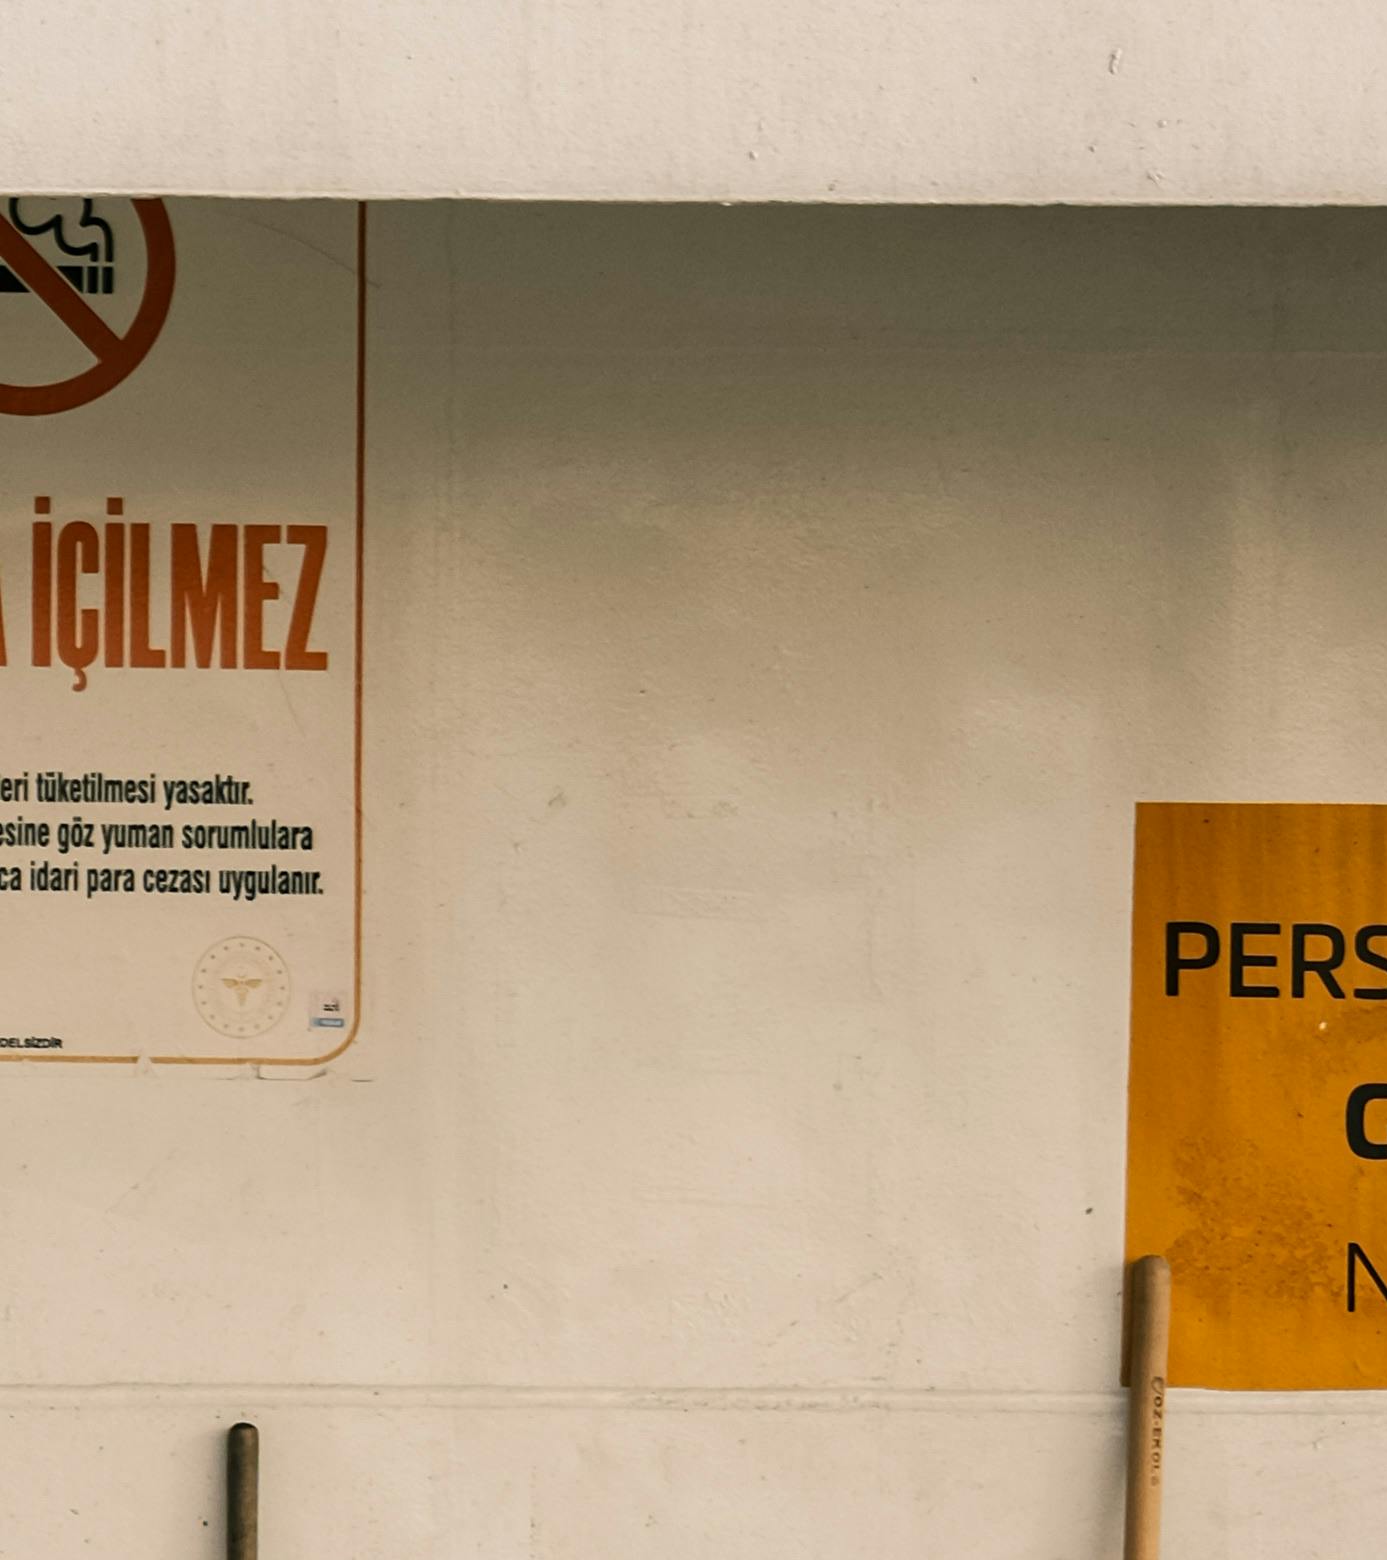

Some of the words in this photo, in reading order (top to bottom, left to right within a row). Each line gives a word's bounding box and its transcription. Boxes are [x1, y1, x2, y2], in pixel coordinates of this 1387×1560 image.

[32, 496, 328, 692] İÇİLMEZ
[36, 772, 156, 804] tüketilmesi
[163, 774, 253, 811] yasaktır.
[57, 816, 95, 854] göz
[100, 823, 174, 854] yuman
[182, 818, 313, 850] sorumlulara
[30, 860, 78, 891] idari
[87, 868, 135, 899] para
[143, 869, 210, 893] cezası
[219, 864, 324, 901] uygulanır.
